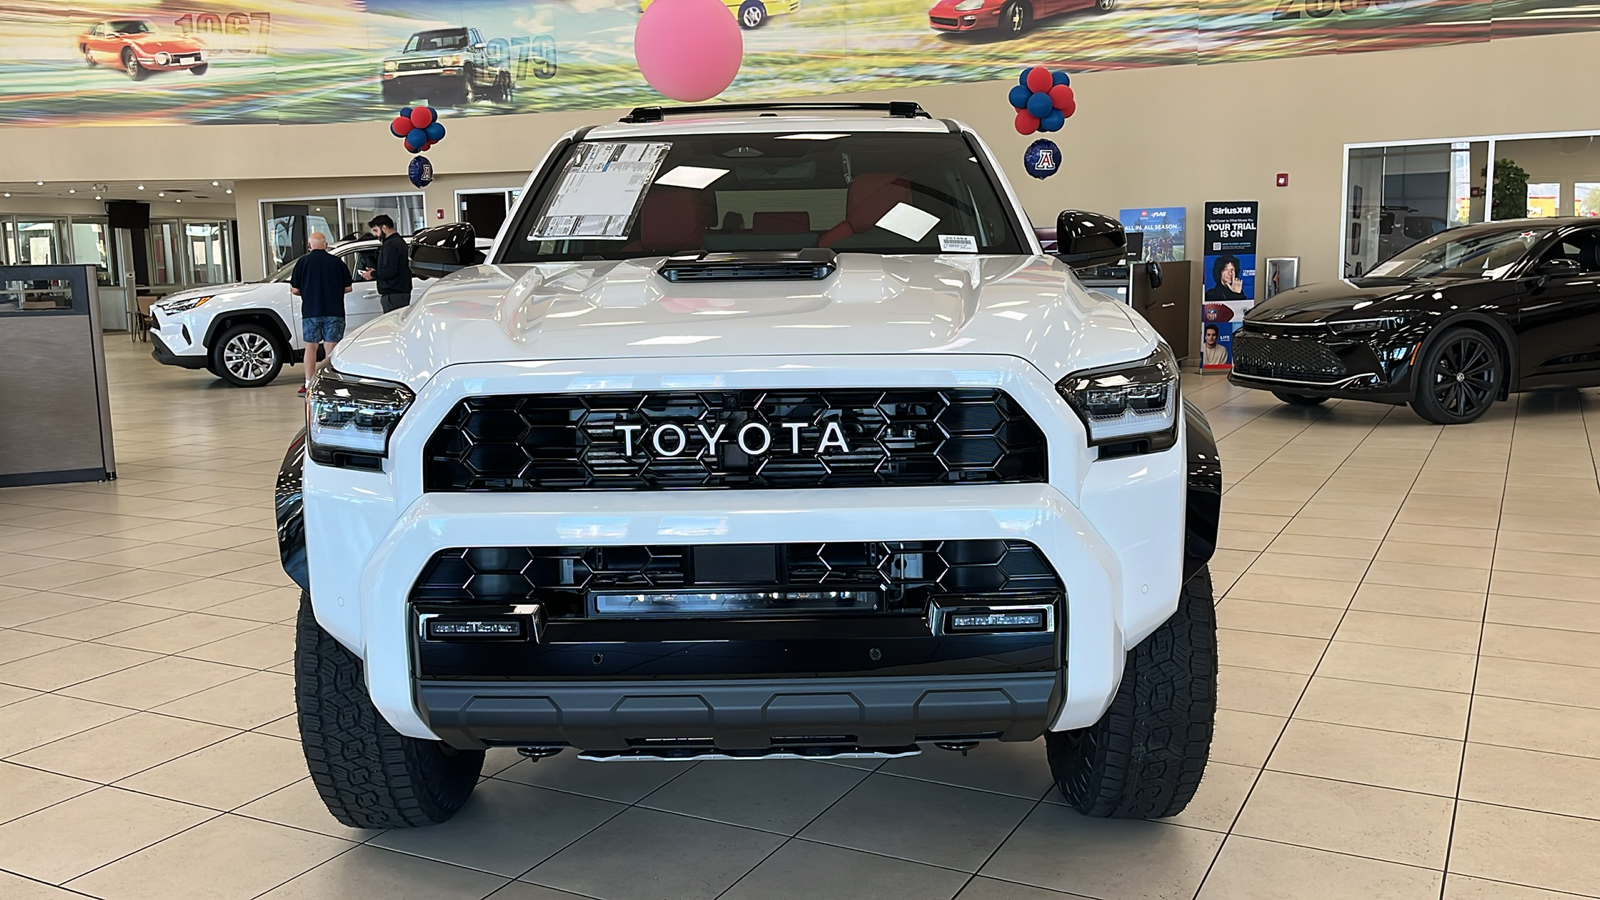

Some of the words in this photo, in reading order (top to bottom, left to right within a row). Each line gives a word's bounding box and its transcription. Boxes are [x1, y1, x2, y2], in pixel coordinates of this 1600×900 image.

[174, 12, 270, 54] 1967
[1035, 150, 1055, 170] A
[1207, 223, 1231, 231] YOUR
[1220, 230, 1229, 238] IS
[1230, 230, 1243, 238] ON
[614, 422, 849, 456] TOYOTA
